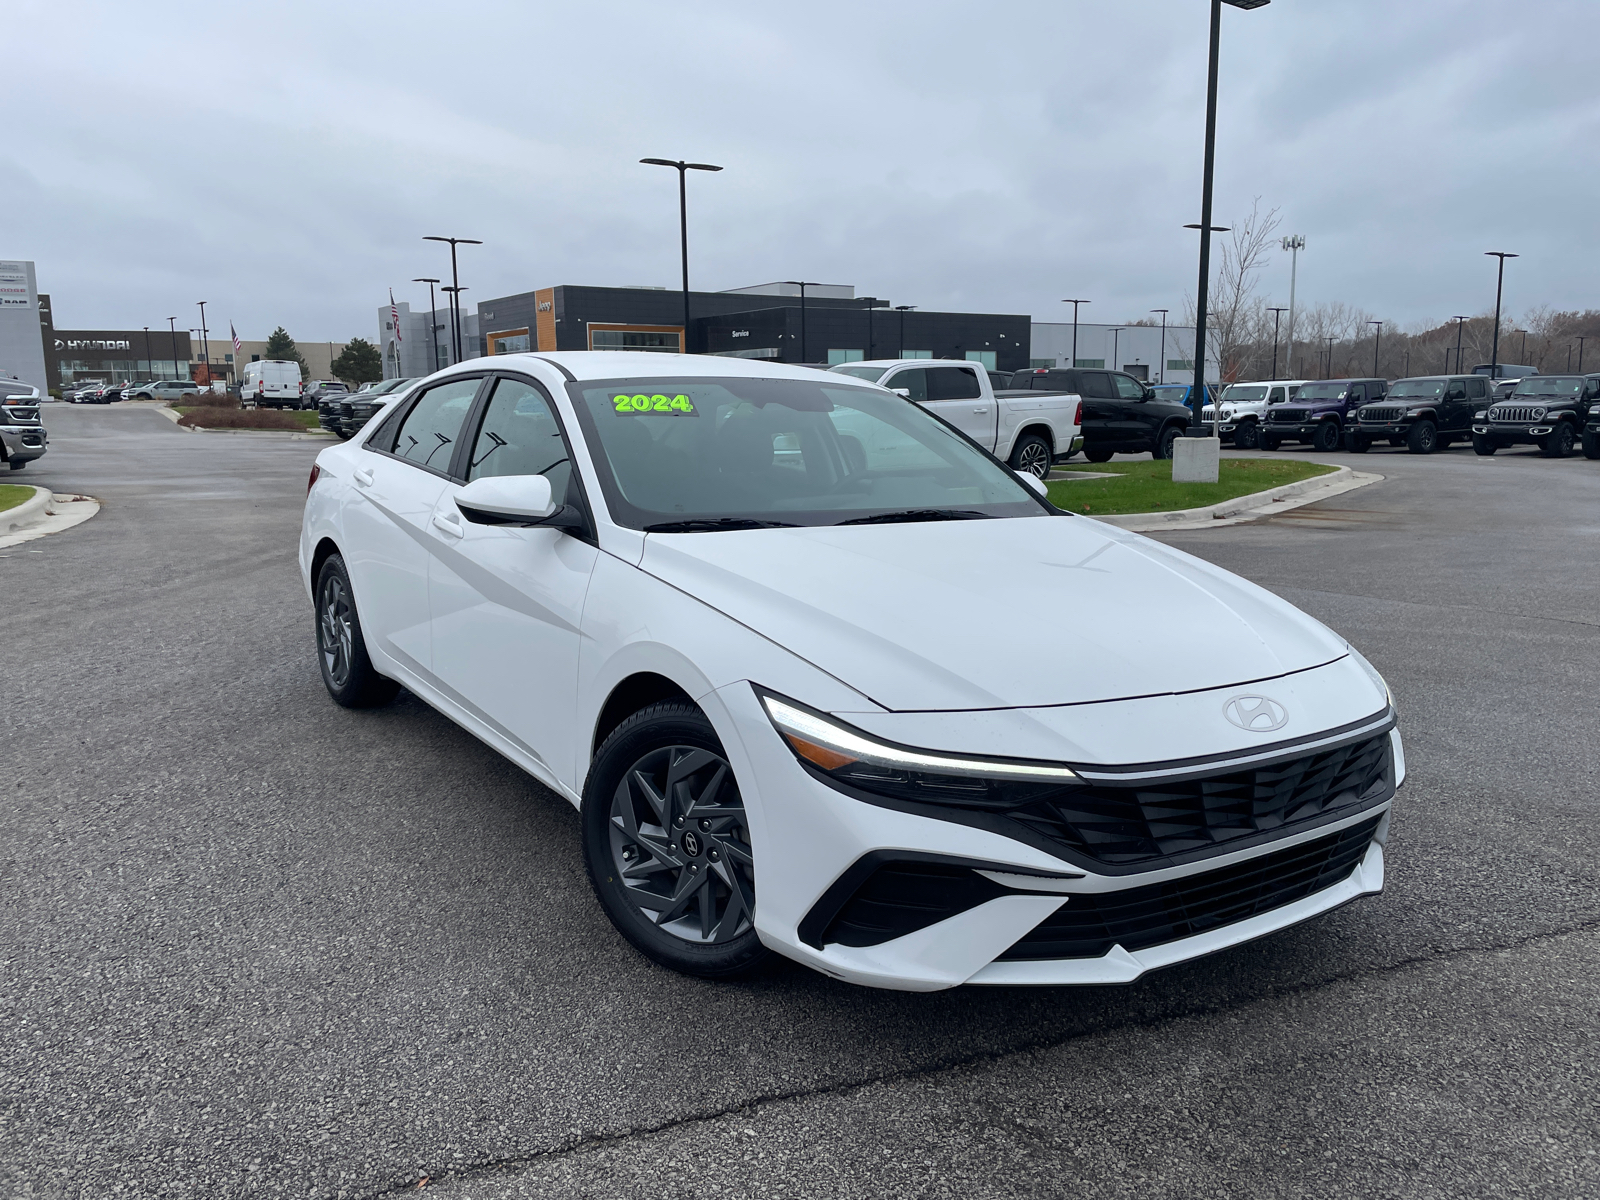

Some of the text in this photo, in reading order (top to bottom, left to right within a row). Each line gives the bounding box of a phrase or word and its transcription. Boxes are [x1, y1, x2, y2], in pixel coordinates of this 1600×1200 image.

[538, 301, 551, 312] Jeep
[732, 330, 750, 338] Service
[67, 340, 130, 350] HYUNDAI
[613, 394, 694, 412] 2024
